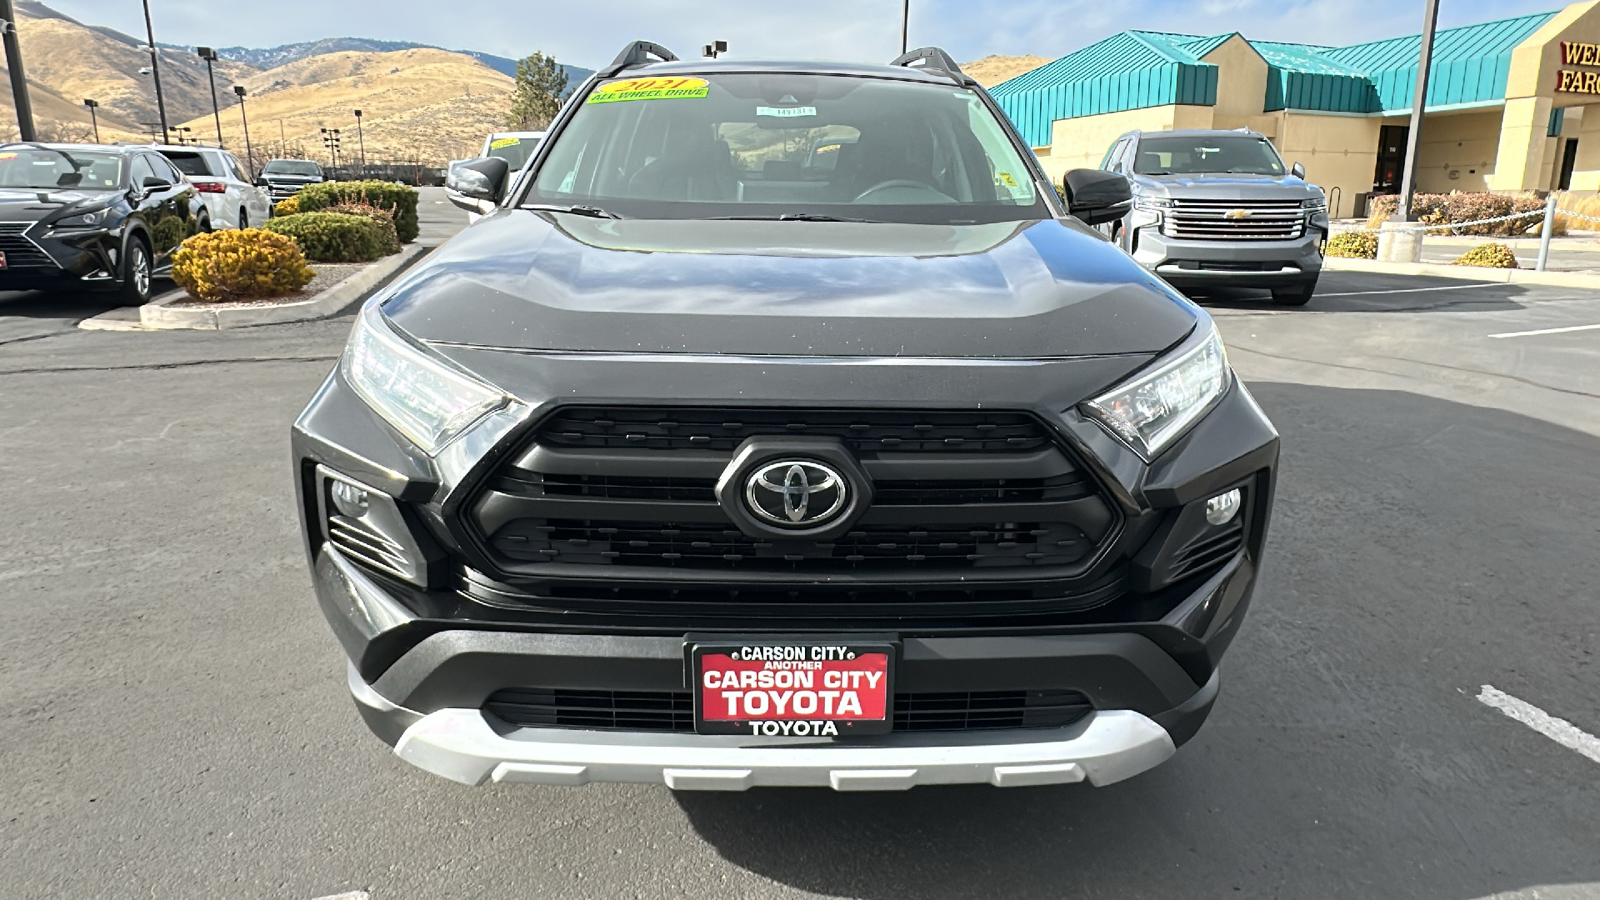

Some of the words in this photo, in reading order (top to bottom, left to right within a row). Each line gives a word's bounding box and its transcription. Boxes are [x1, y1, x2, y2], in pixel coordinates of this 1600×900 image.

[615, 79, 689, 92] 2021
[1557, 70, 1600, 94] FAR
[591, 93, 616, 101] ALL
[618, 90, 662, 98] WHEEL
[664, 88, 705, 96] DRIVE
[741, 646, 806, 661] CARSON
[811, 646, 847, 661] CITY
[764, 661, 822, 670] ANOTHER
[703, 670, 814, 689] CARSON
[823, 671, 883, 689] CITY
[721, 690, 863, 715] TOYOTA
[748, 720, 839, 736] TOYOTA
